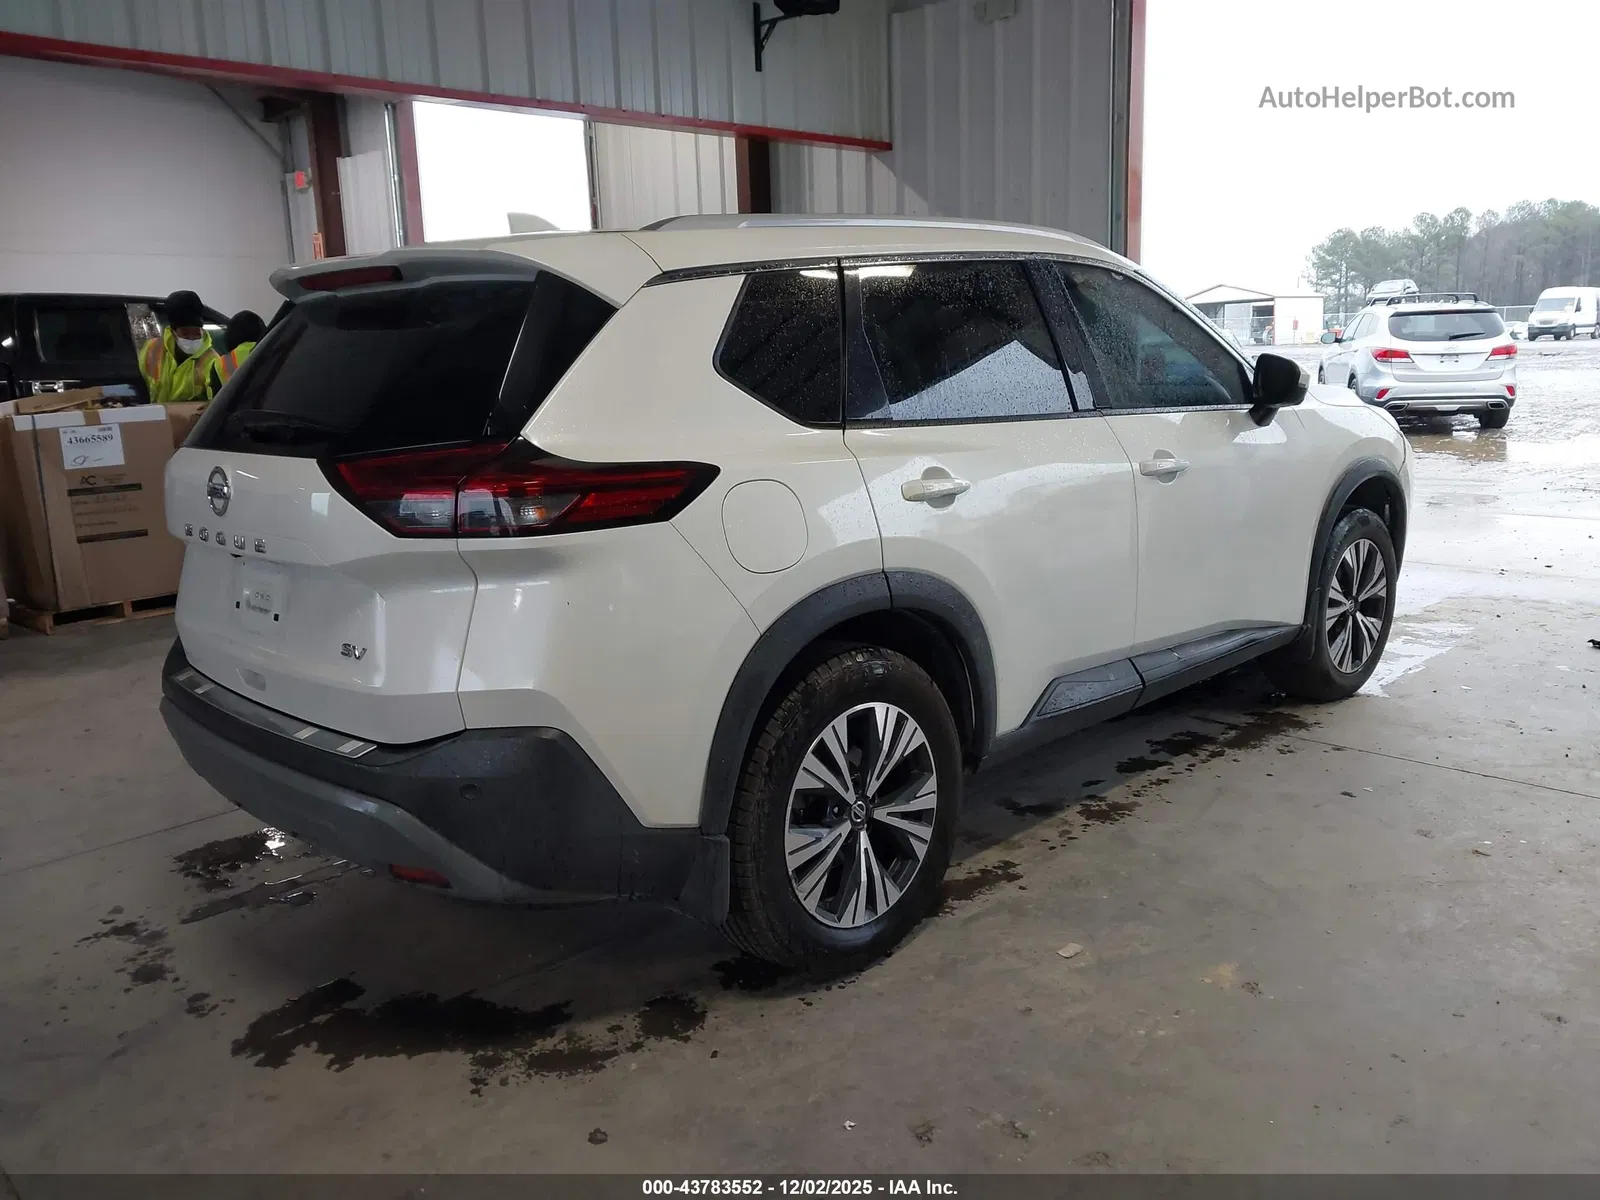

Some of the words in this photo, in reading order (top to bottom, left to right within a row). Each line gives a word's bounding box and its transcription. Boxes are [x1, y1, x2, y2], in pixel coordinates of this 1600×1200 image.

[67, 433, 114, 445] 43665589
[184, 523, 267, 554] ROGUE
[340, 642, 368, 661] SV
